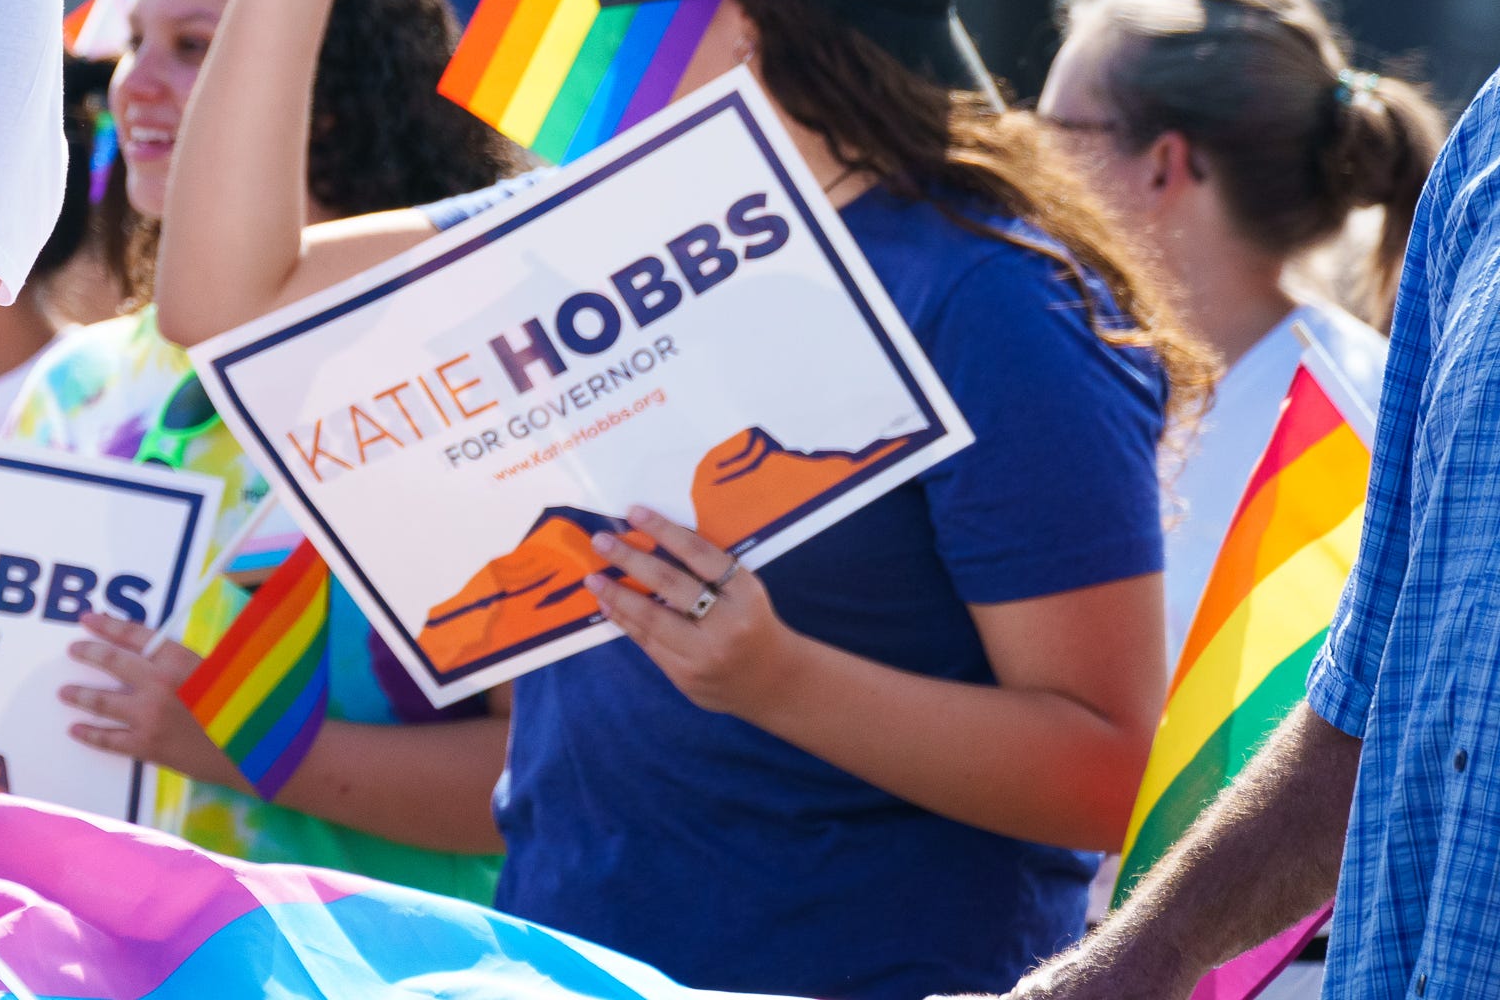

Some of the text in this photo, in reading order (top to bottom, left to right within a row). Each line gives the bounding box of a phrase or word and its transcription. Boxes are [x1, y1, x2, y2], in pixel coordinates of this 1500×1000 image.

[286, 192, 791, 483] KATIE HOBBS
[443, 335, 679, 468] FOR GOVERNOR
[493, 387, 668, 481] www.KatieHobbs.org
